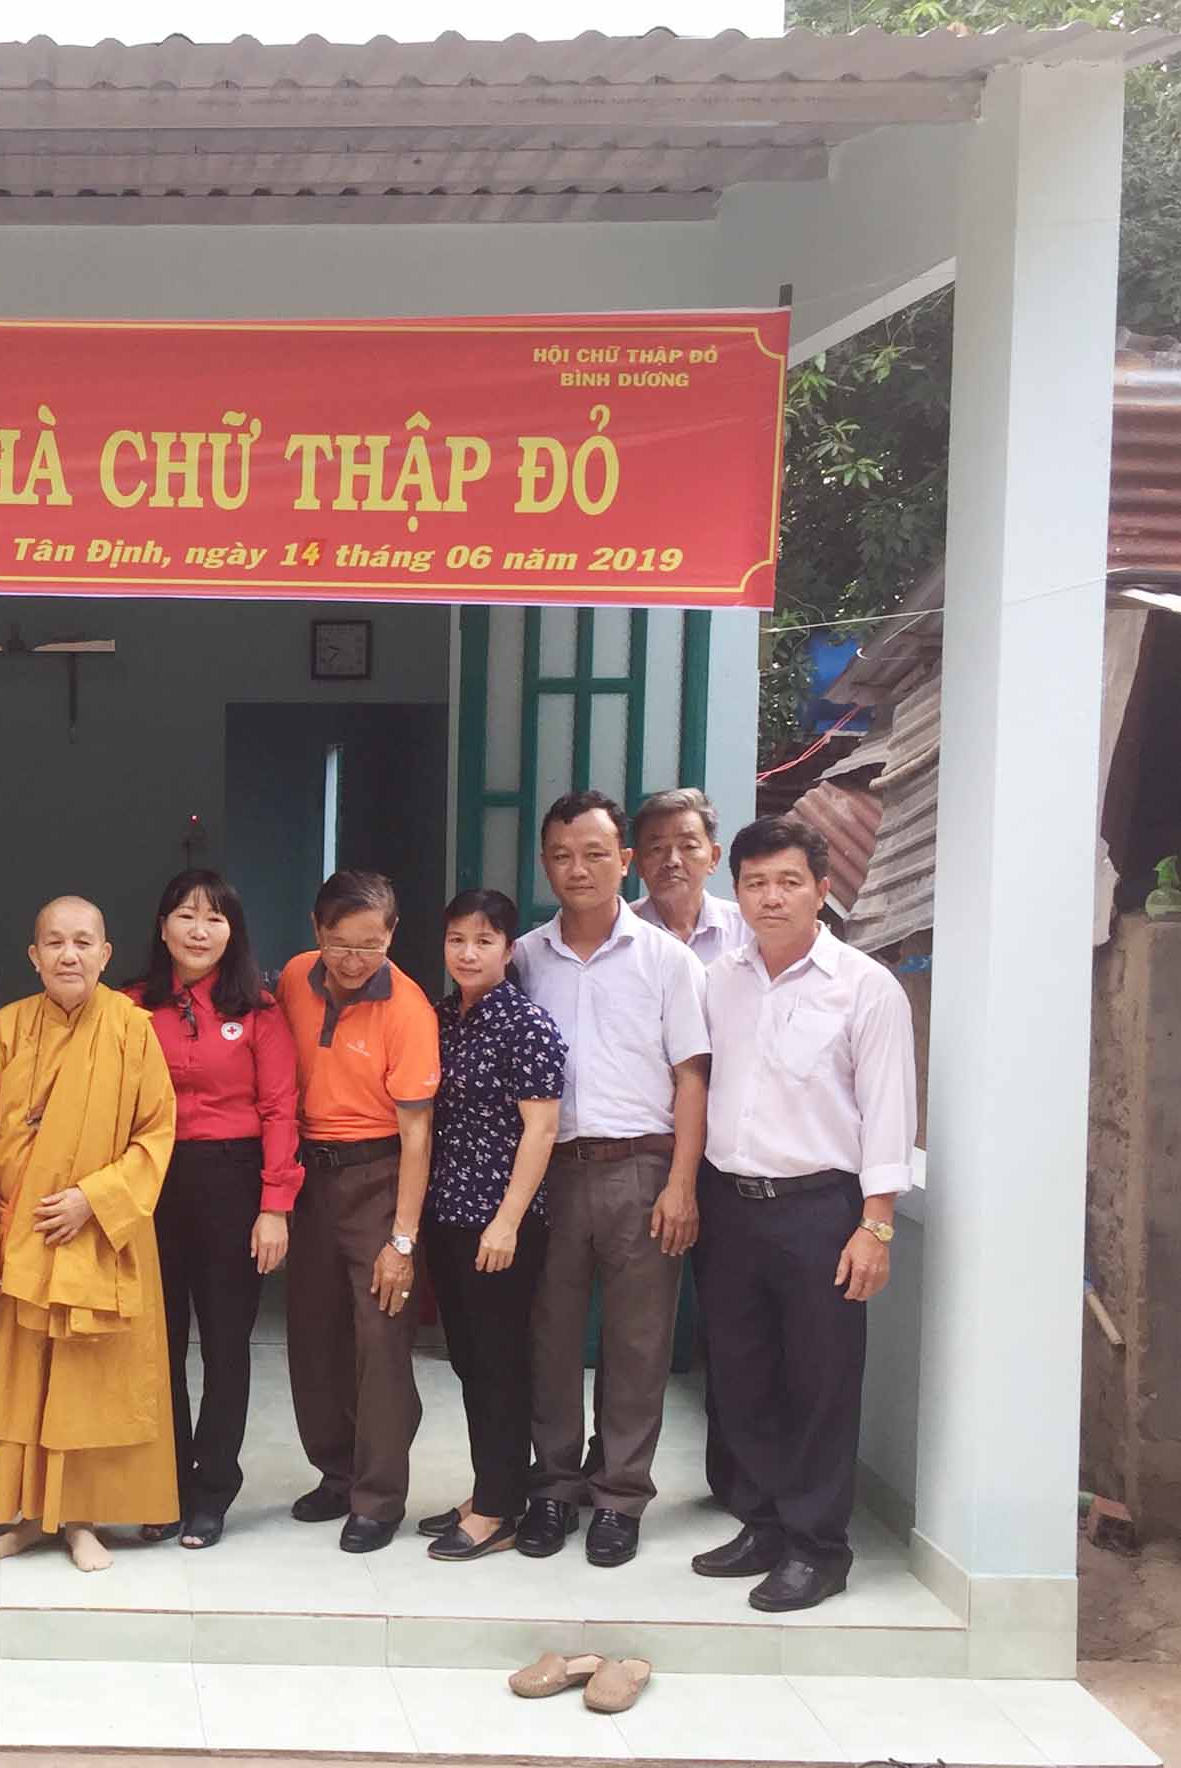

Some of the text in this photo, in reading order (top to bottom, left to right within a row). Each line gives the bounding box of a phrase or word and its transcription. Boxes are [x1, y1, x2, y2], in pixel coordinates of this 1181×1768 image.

[533, 344, 718, 366] HỘI CHỮ THẬP ĐỎ
[560, 369, 689, 387] BÌNH DƯƠNG
[99, 410, 261, 510] CHỮ
[284, 410, 492, 533] THẬP
[514, 404, 619, 515] ĐỎ
[14, 538, 683, 572] Tân Định, ngày 14 tháng 06 năm 2019
